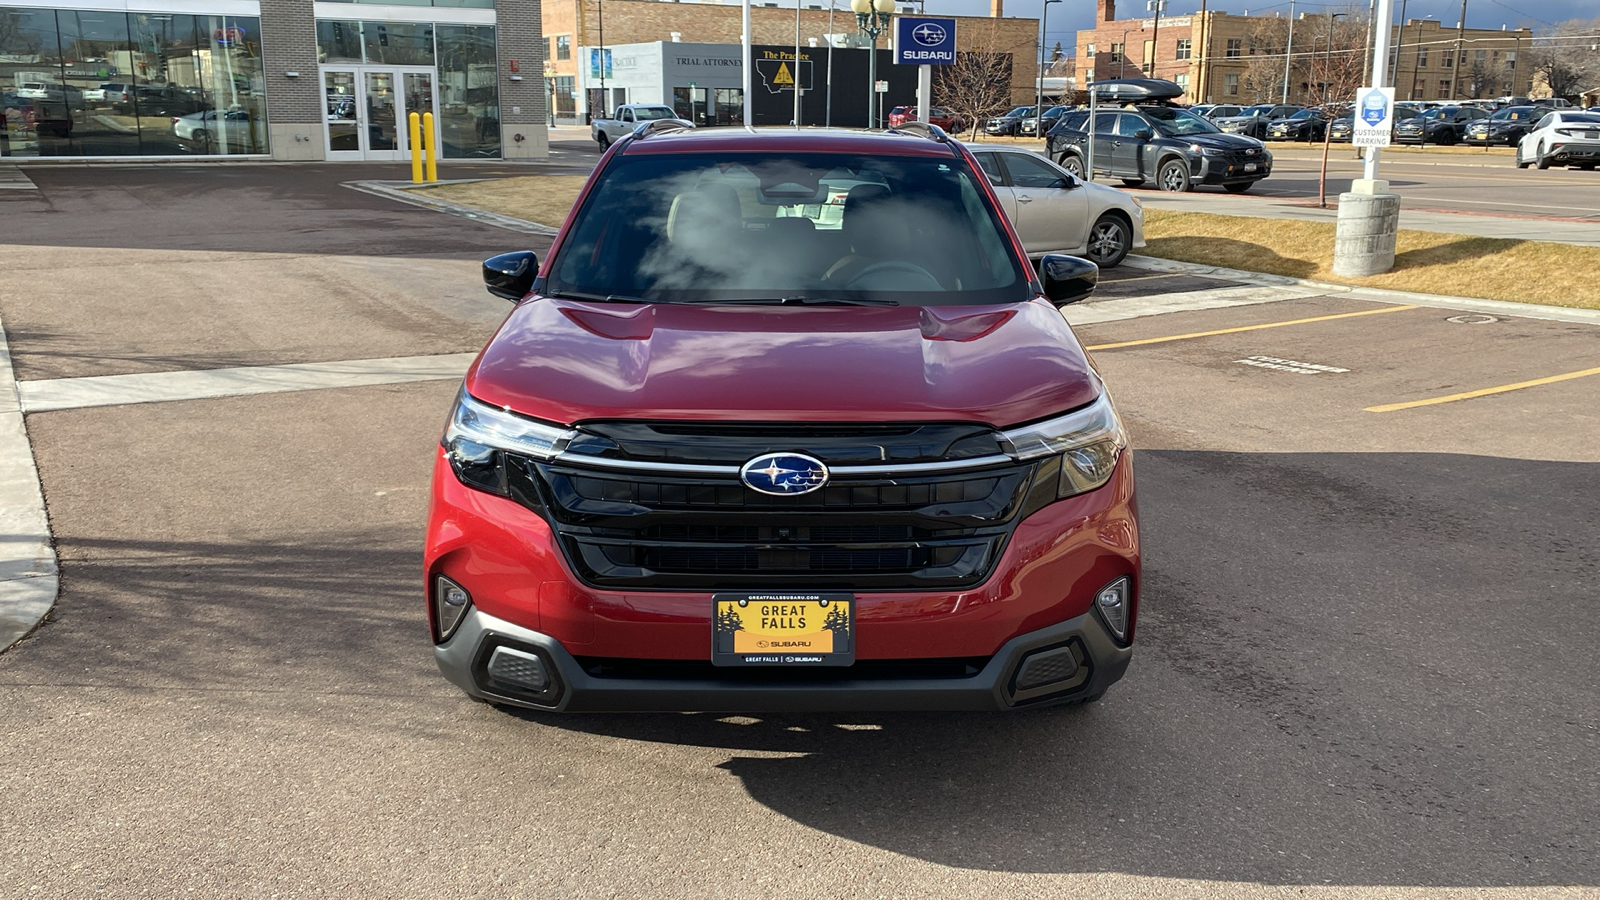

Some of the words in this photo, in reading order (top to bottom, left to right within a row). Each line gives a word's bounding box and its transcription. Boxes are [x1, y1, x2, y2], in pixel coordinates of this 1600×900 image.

[763, 50, 778, 59] The
[780, 51, 810, 60] Pracice
[903, 50, 952, 60] SUBARU
[676, 57, 701, 66] TRIAL
[1354, 129, 1391, 137] CUSTOMER
[1356, 137, 1386, 145] PARKING
[761, 605, 806, 616] GREAT
[761, 617, 806, 629] FALLS
